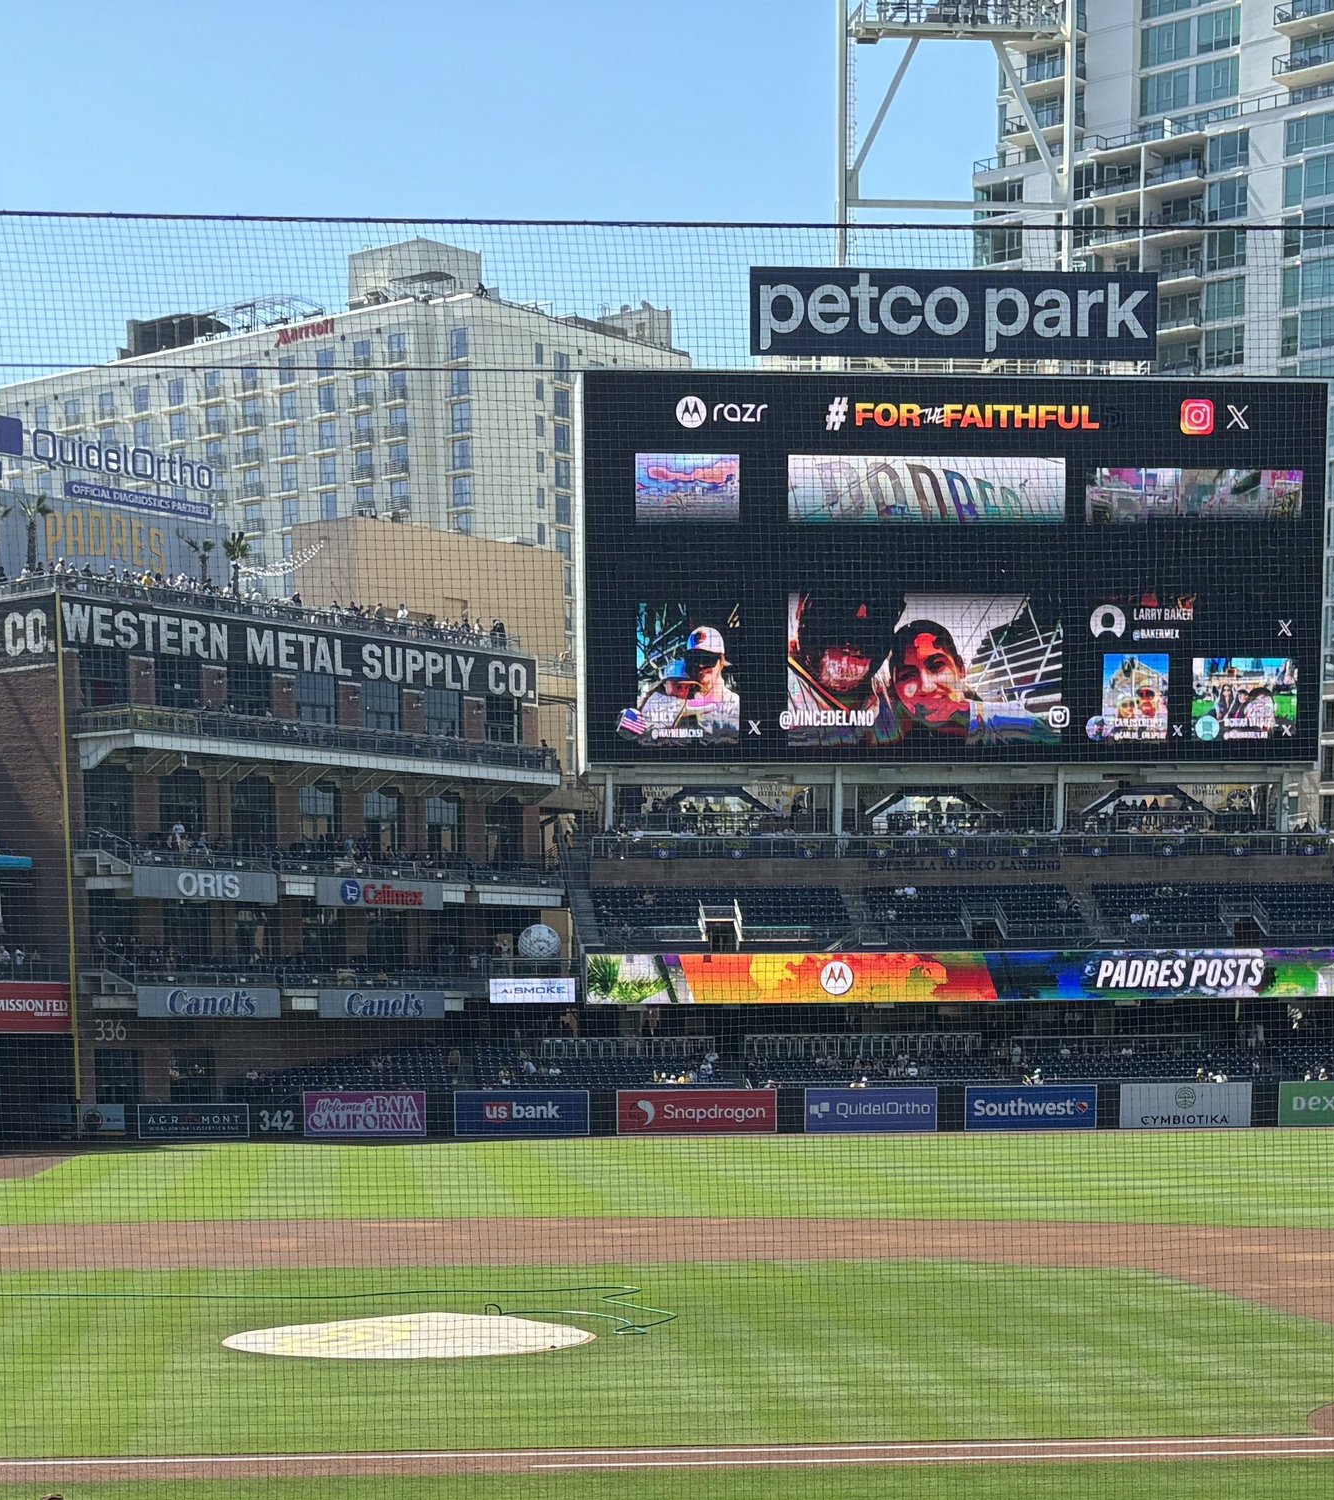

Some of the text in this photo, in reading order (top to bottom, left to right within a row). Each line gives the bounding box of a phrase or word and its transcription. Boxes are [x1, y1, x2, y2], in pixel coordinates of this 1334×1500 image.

[758, 273, 1150, 353] petco park
[274, 318, 335, 348] Marriott
[713, 403, 768, 423] razr
[33, 428, 214, 491] QuidelOrtho
[72, 484, 209, 516] OFFICIAL DIAGNOSTICS PARTNER
[44, 510, 166, 576] PADRES
[61, 602, 535, 700] WESTERN METAL SUPPLY CO.
[941, 860, 995, 871] JALISCO
[999, 859, 1061, 872] LANDING
[178, 871, 241, 899] ORIS
[1095, 957, 1265, 989] PADRES POSTS
[46, 1000, 68, 1012] FED
[167, 989, 257, 1017] Canel's
[344, 989, 424, 1017] Canel's
[95, 1019, 127, 1041] 336
[485, 1101, 560, 1119] us bank
[663, 1103, 766, 1124] Snapdragon
[835, 1100, 931, 1119] QuidelOrtho
[973, 1098, 1075, 1117] Southwest
[259, 1109, 295, 1131] 342
[308, 1113, 422, 1131] CALIFORNIA
[1141, 1114, 1229, 1126] CYMBIOTIKA
